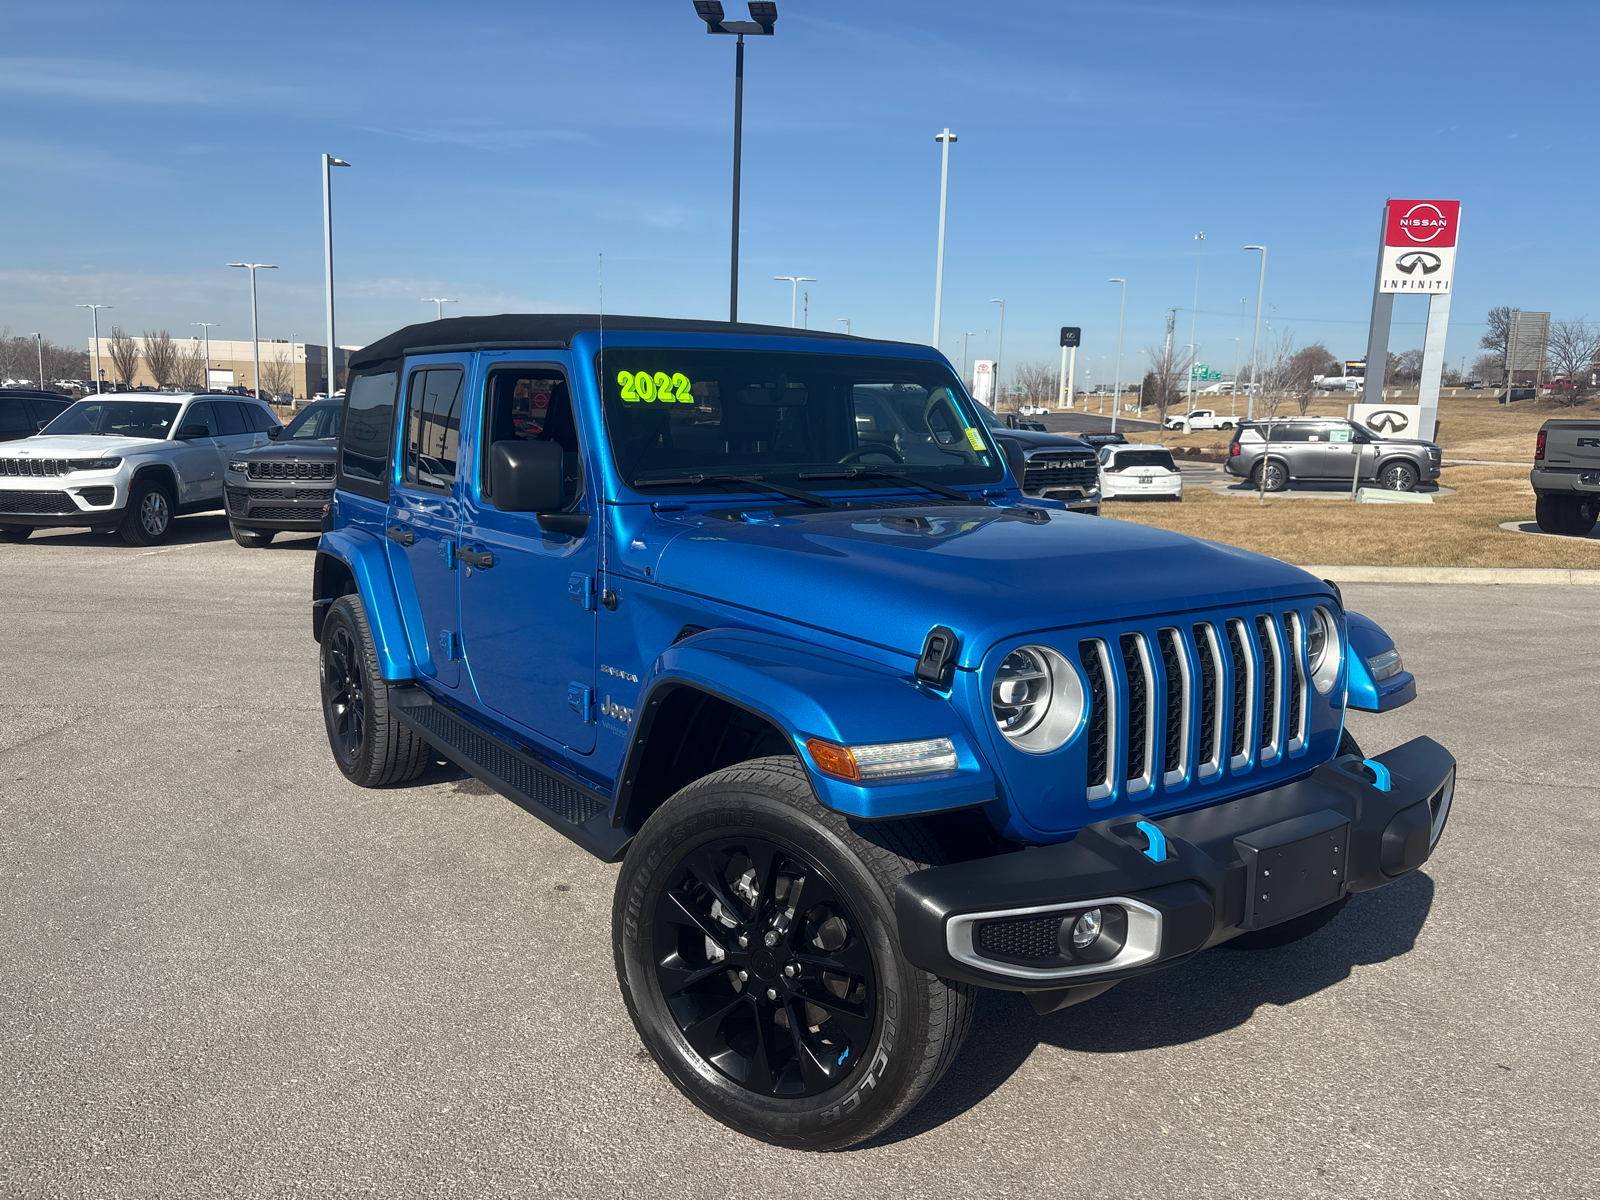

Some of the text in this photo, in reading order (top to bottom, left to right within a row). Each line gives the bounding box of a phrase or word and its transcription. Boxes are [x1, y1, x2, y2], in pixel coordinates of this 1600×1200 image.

[1400, 219, 1447, 227] NISSAN
[1384, 280, 1449, 289] INFINITI
[617, 370, 694, 403] 2022
[1048, 461, 1084, 469] RAM
[624, 810, 755, 943] BRIDGESTONE
[820, 985, 898, 1126] DUELER
